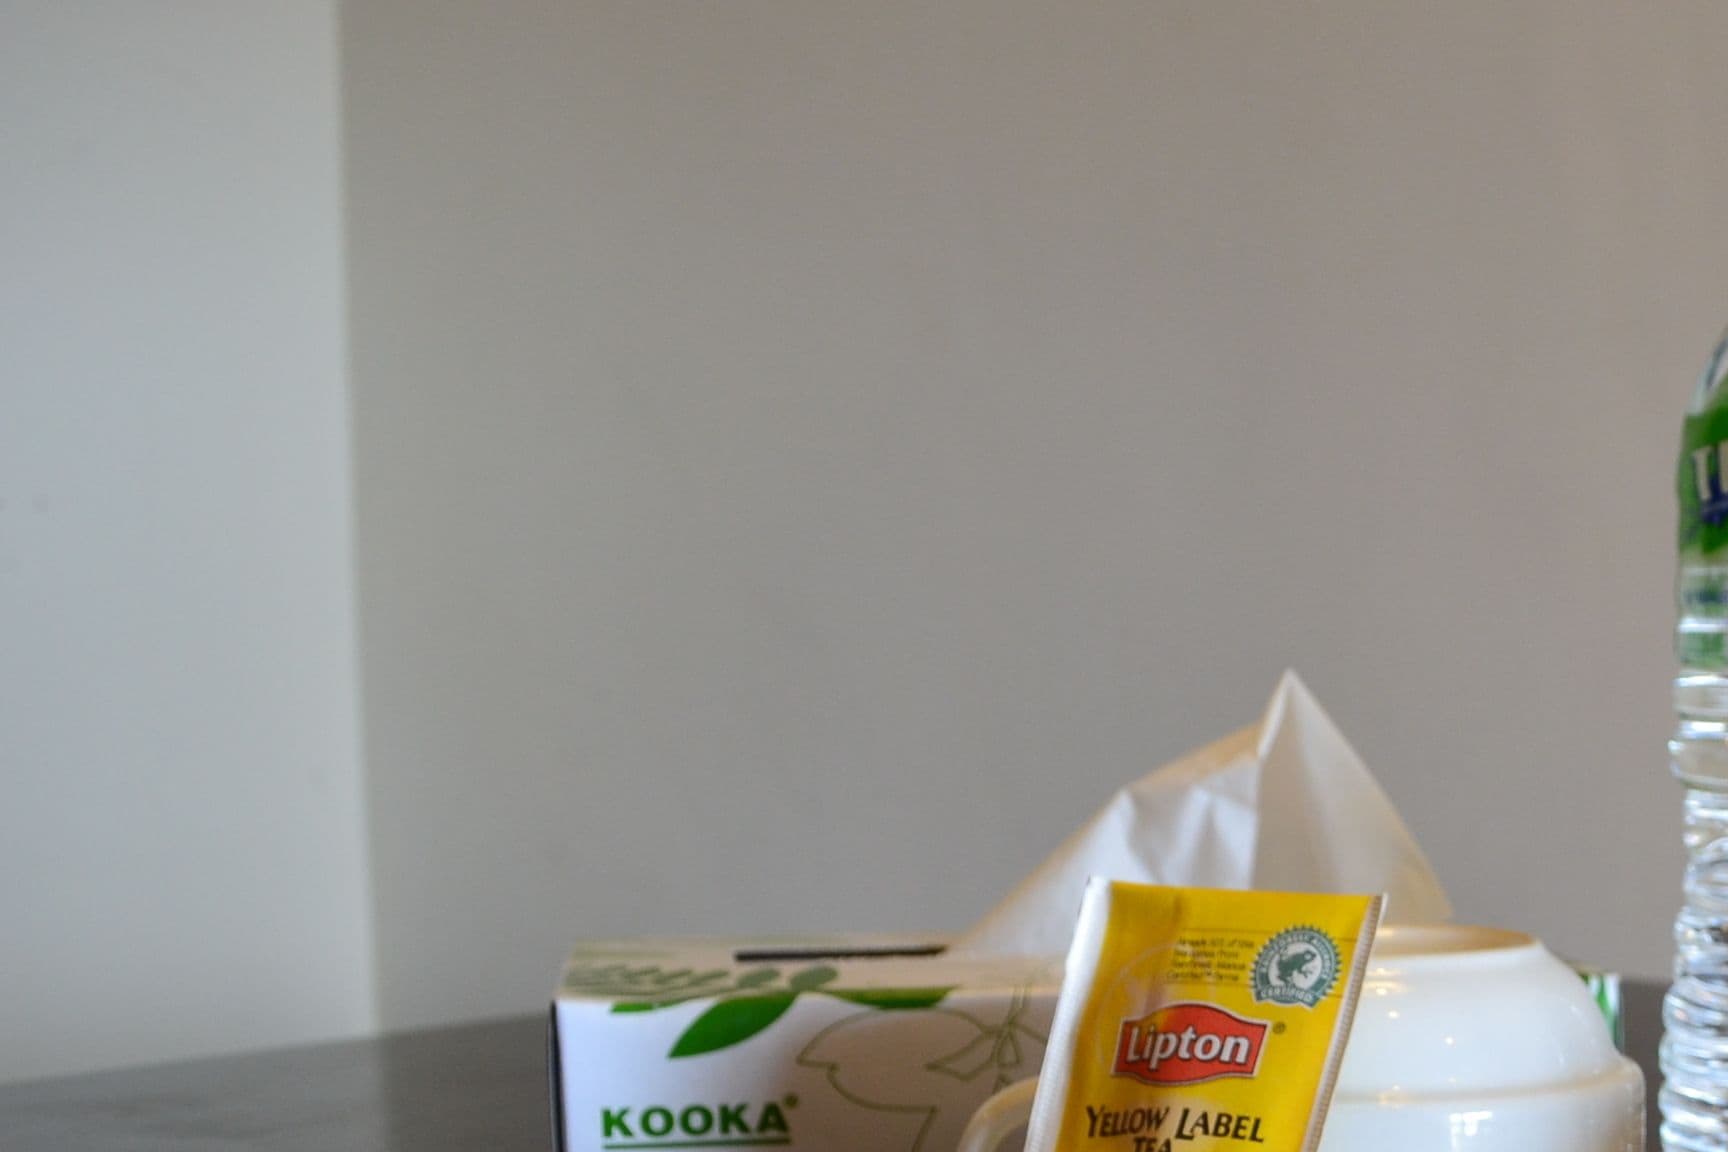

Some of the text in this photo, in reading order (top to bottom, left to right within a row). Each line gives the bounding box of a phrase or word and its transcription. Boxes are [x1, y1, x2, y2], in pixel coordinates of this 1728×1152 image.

[1124, 1025, 1252, 1071] Lipton
[602, 1101, 790, 1137] KOOKA
[1085, 1104, 1265, 1143] YELLOW LABEL
